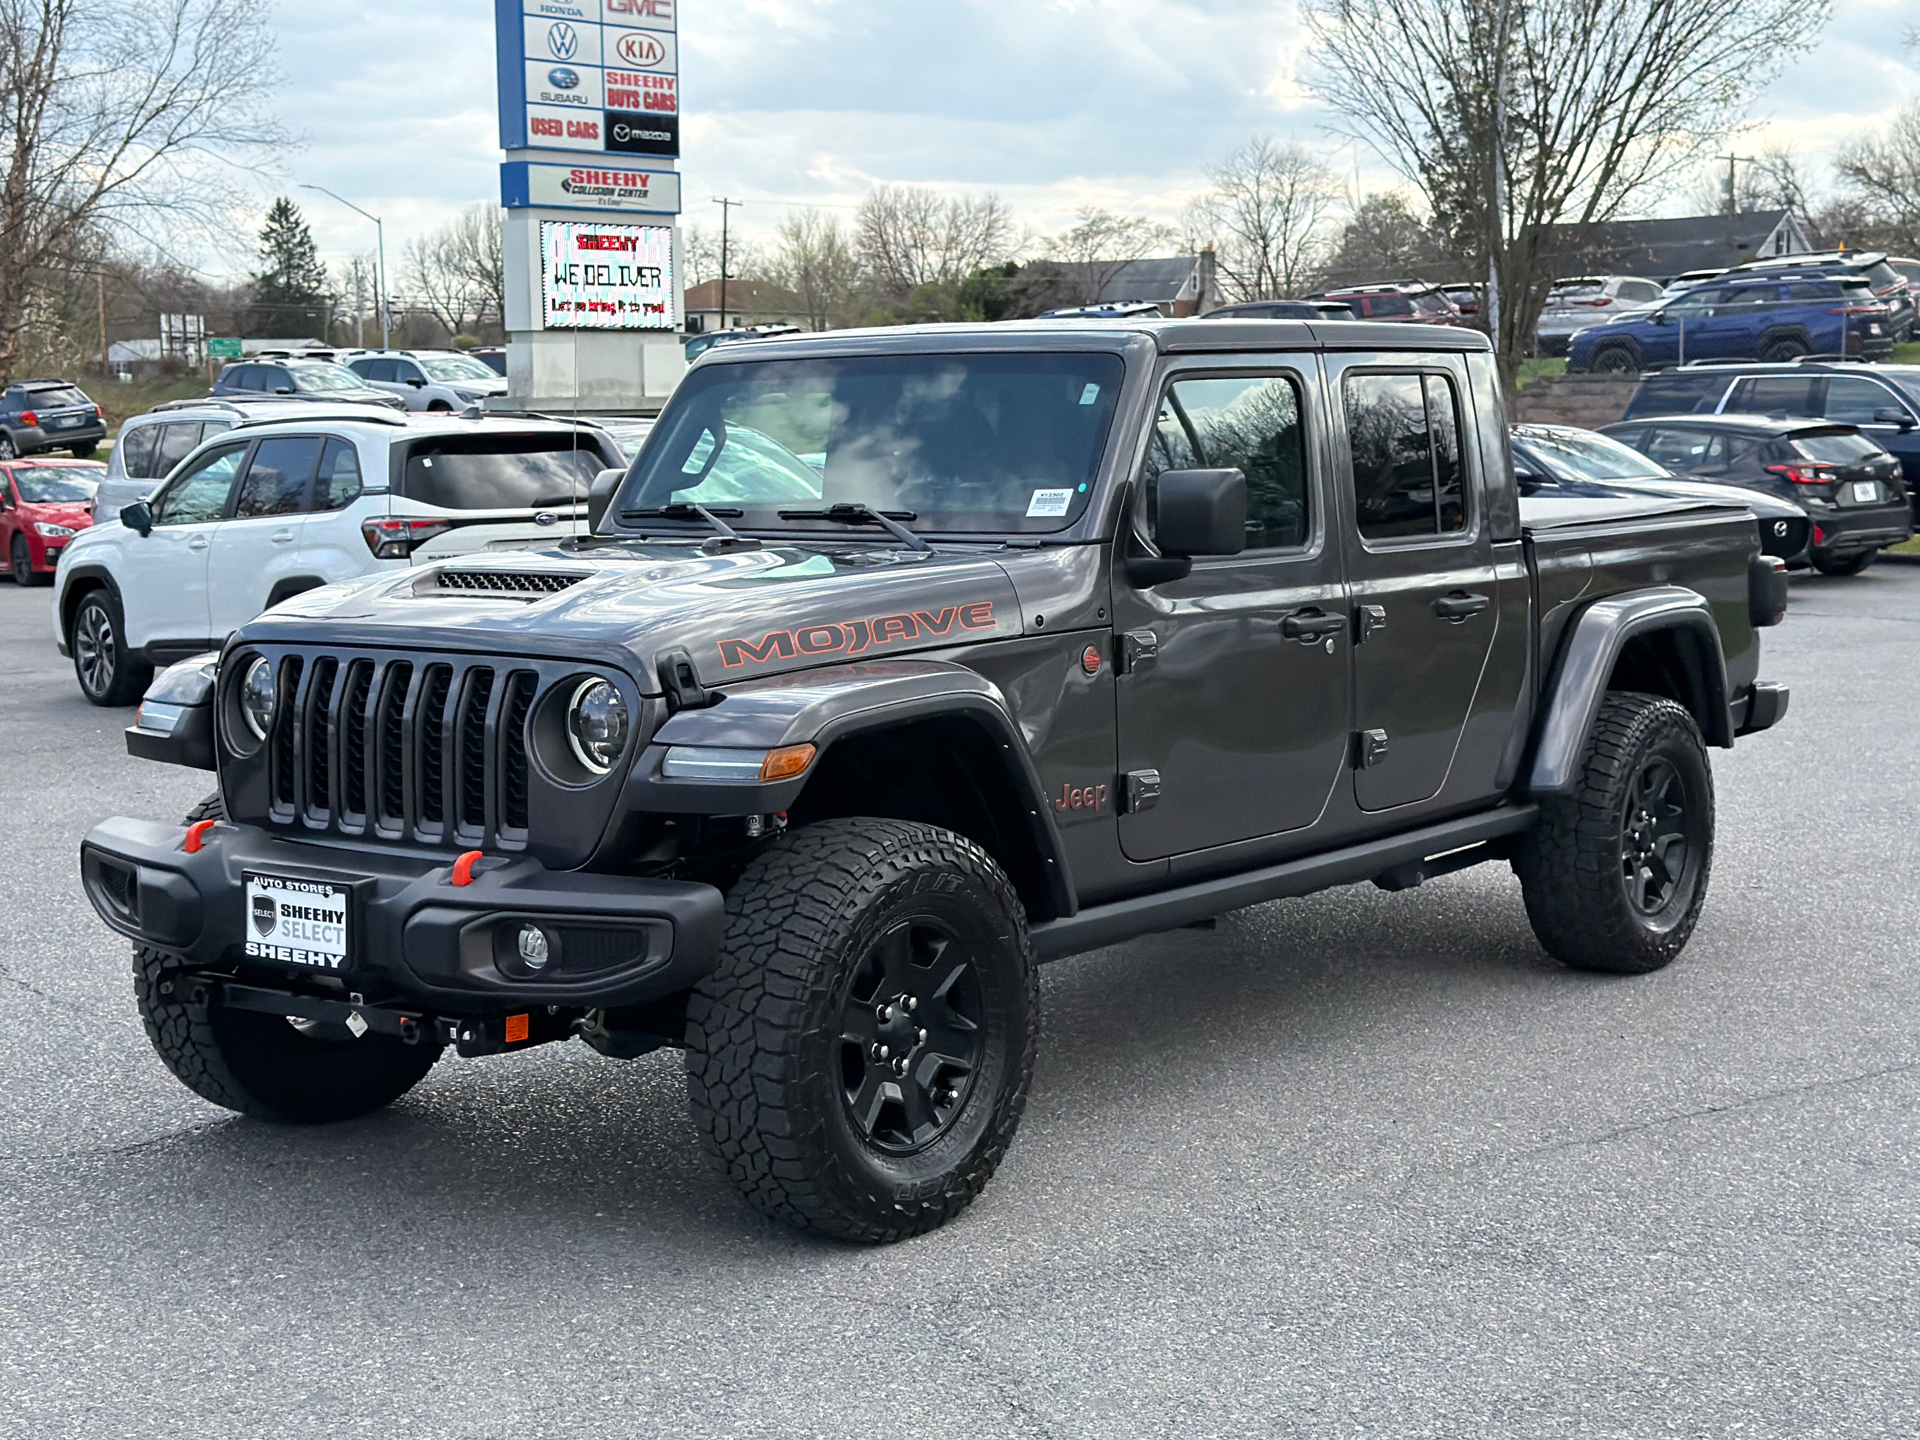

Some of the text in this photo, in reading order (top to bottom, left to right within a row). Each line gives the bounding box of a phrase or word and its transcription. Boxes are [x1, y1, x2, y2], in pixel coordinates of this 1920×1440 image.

[540, 4, 584, 17] HONDA
[607, 0, 672, 19] GMC
[625, 39, 658, 60] KIA
[606, 71, 676, 90] SHEEHY
[540, 92, 588, 105] SUBARU
[607, 88, 677, 112] BUYS CARS
[531, 117, 599, 140] USED CARS
[570, 169, 650, 188] SHEEHY
[571, 185, 649, 198] COLLISION CENTER
[555, 263, 661, 288] WE DELIVER
[716, 601, 998, 668] MOJAVE
[1055, 783, 1107, 813] Jeep
[253, 876, 334, 895] AUTO STORES
[253, 908, 276, 919] SELECT
[280, 903, 345, 925] SHEEHY
[281, 919, 345, 945] SELECT
[245, 942, 344, 969] SHEEHY
